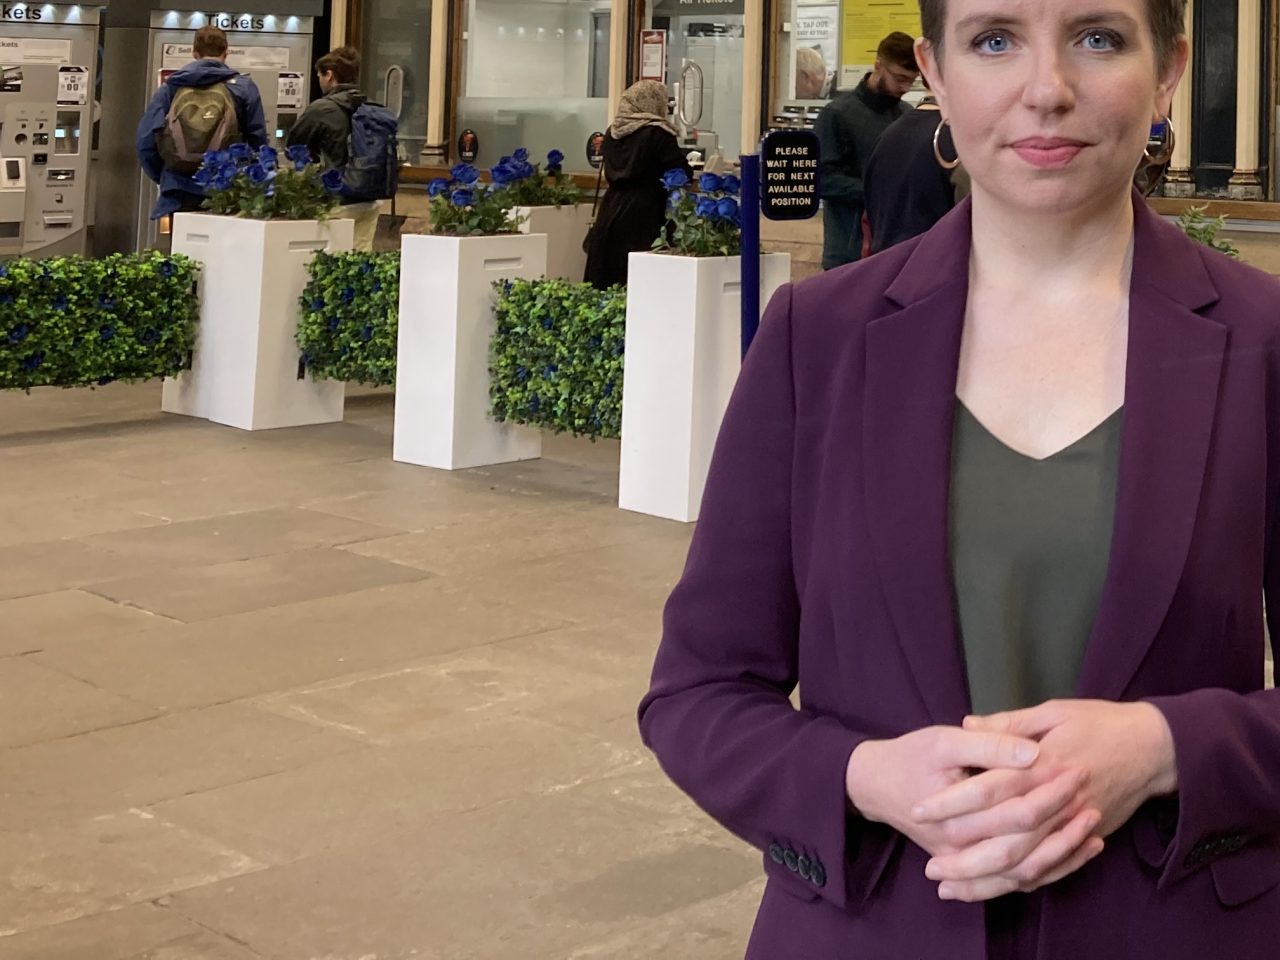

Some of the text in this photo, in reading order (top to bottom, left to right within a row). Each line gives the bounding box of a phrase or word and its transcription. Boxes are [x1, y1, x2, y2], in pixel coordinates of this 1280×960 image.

[775, 146, 809, 156] PLEASE
[766, 159, 817, 168] WAIT HERE
[767, 172, 816, 181] FOR NEXT
[767, 184, 815, 194] AVAILABLE
[771, 197, 811, 206] POSITION
